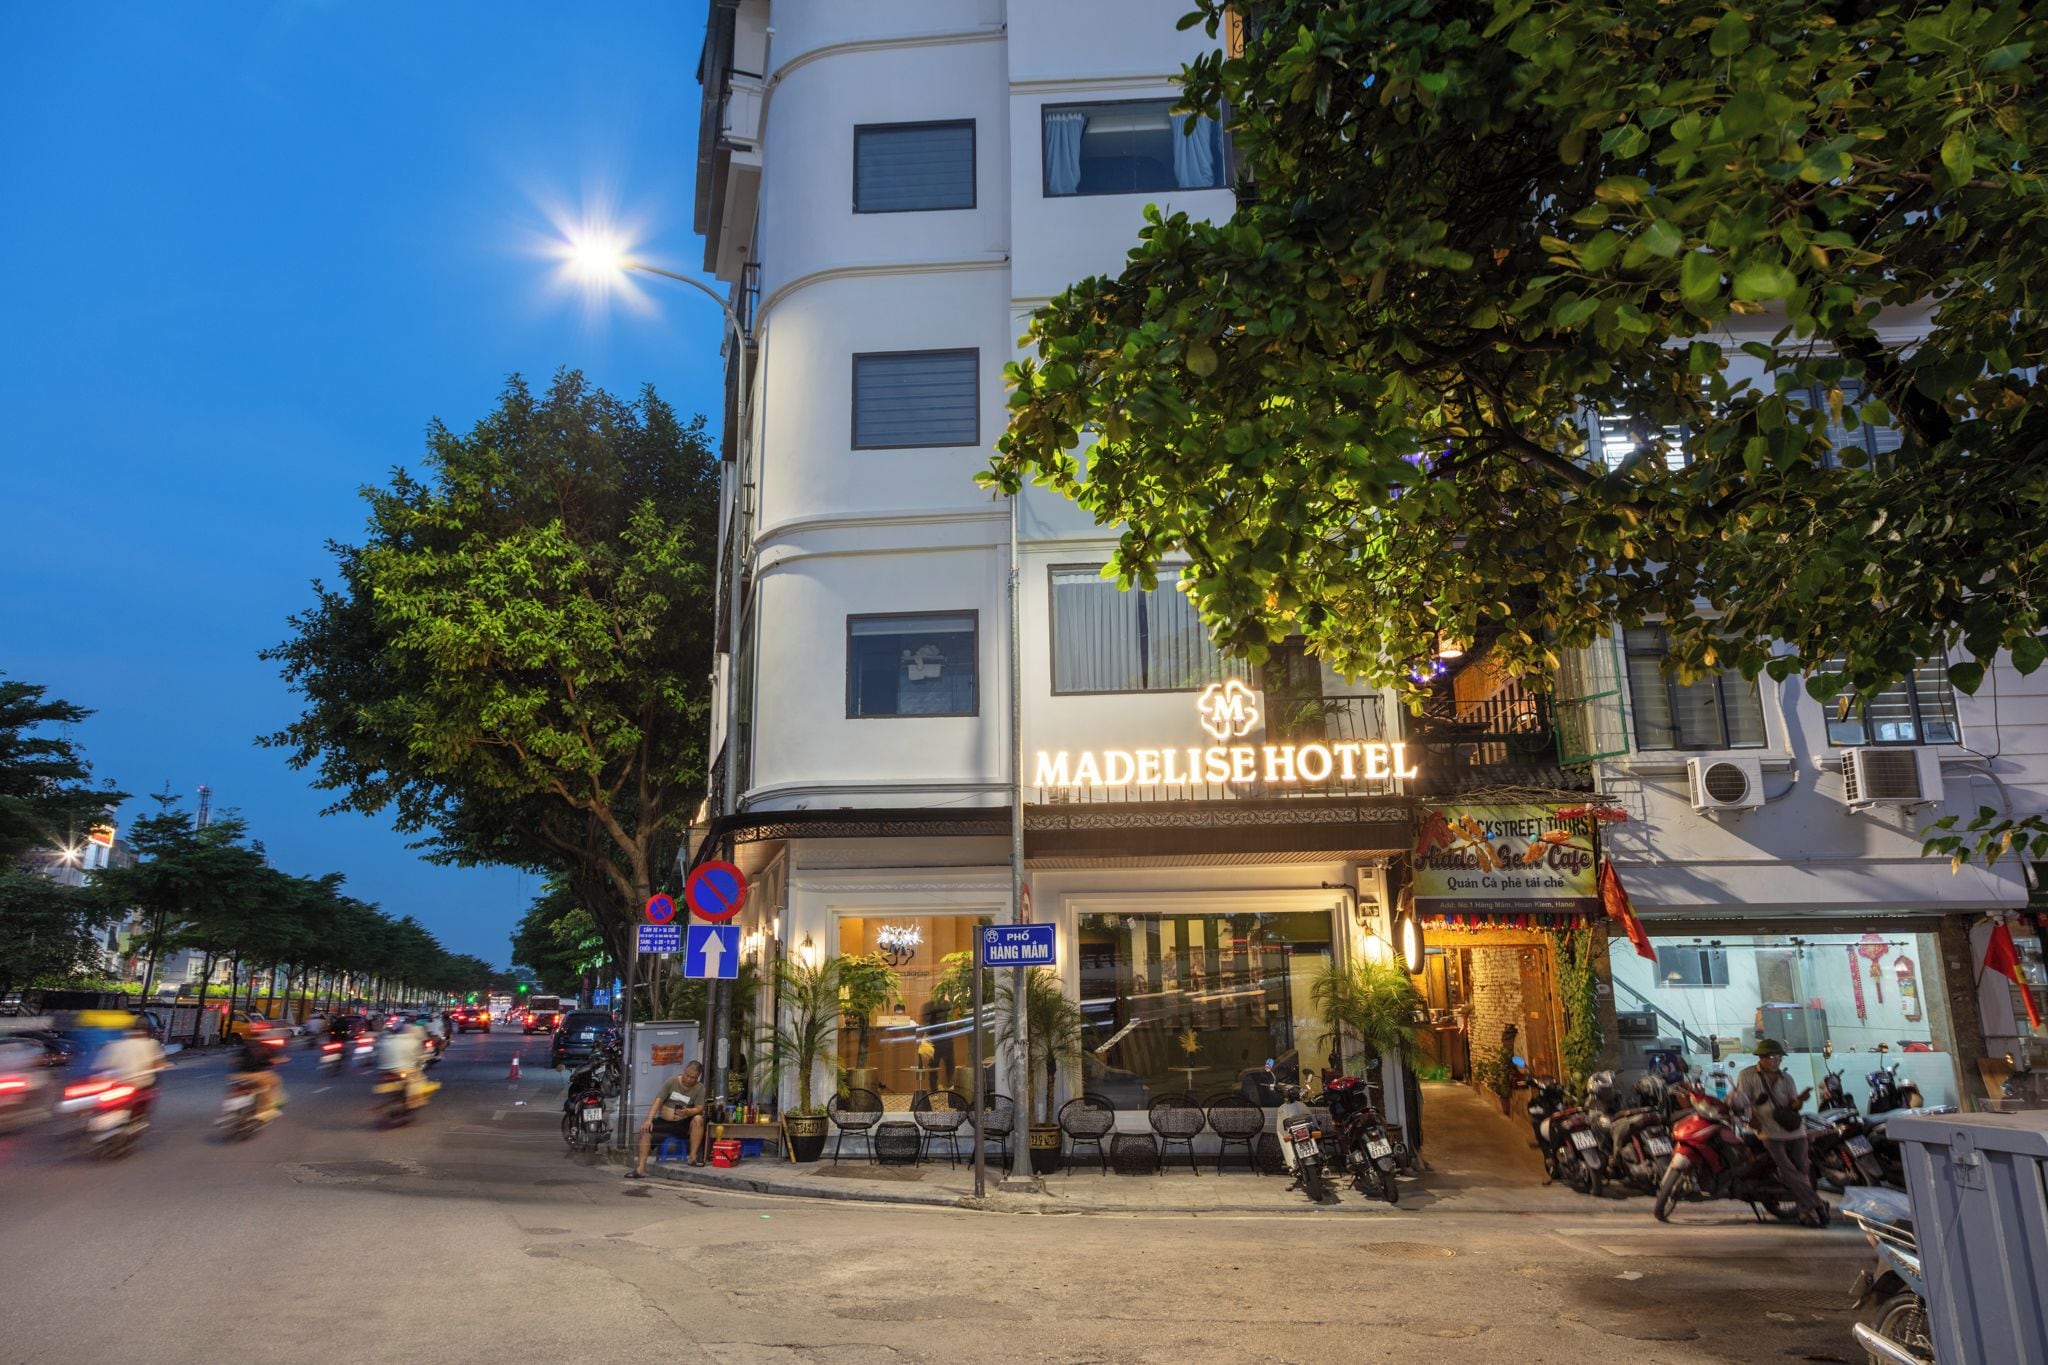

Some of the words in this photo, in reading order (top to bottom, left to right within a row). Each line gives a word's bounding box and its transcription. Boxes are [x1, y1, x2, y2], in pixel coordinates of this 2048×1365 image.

[1034, 747, 1257, 786] MADELISE
[1262, 742, 1419, 783] HOTEL
[1414, 845, 1490, 871] Hidde
[1447, 876, 1478, 890] Quán
[1006, 929, 1030, 941] PHỐ
[990, 942, 1019, 960] HÀNG
[1021, 940, 1048, 959] MẮM
